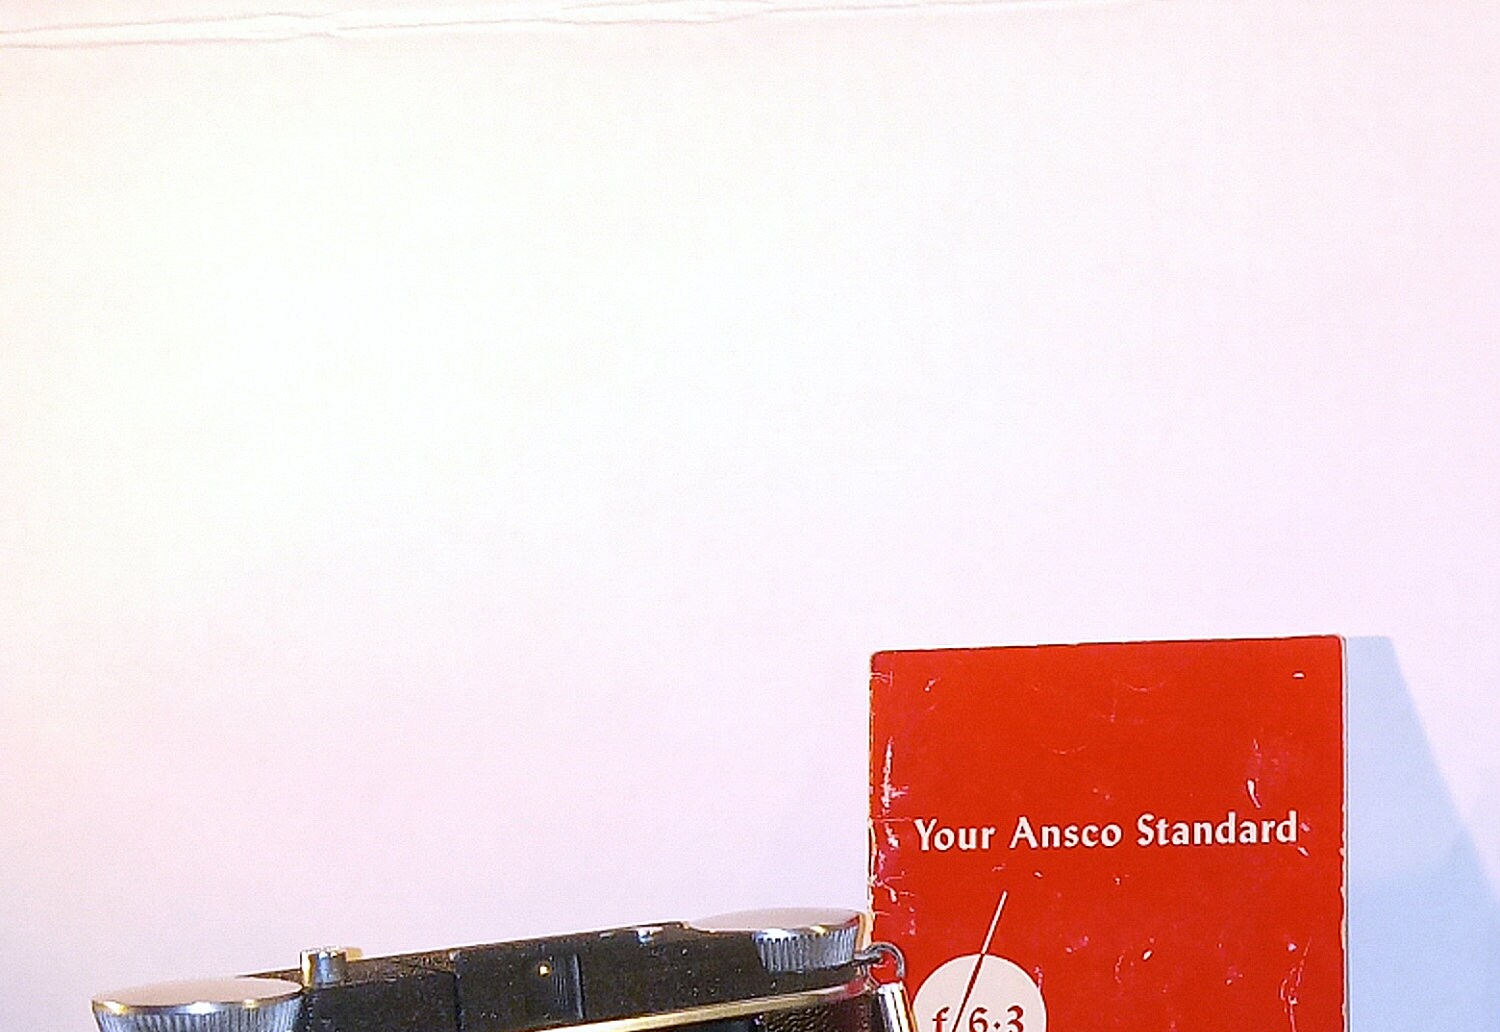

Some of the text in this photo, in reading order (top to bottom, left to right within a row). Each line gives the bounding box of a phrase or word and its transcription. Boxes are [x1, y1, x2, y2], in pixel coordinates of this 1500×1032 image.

[915, 810, 1297, 851] Your Ansco Standard
